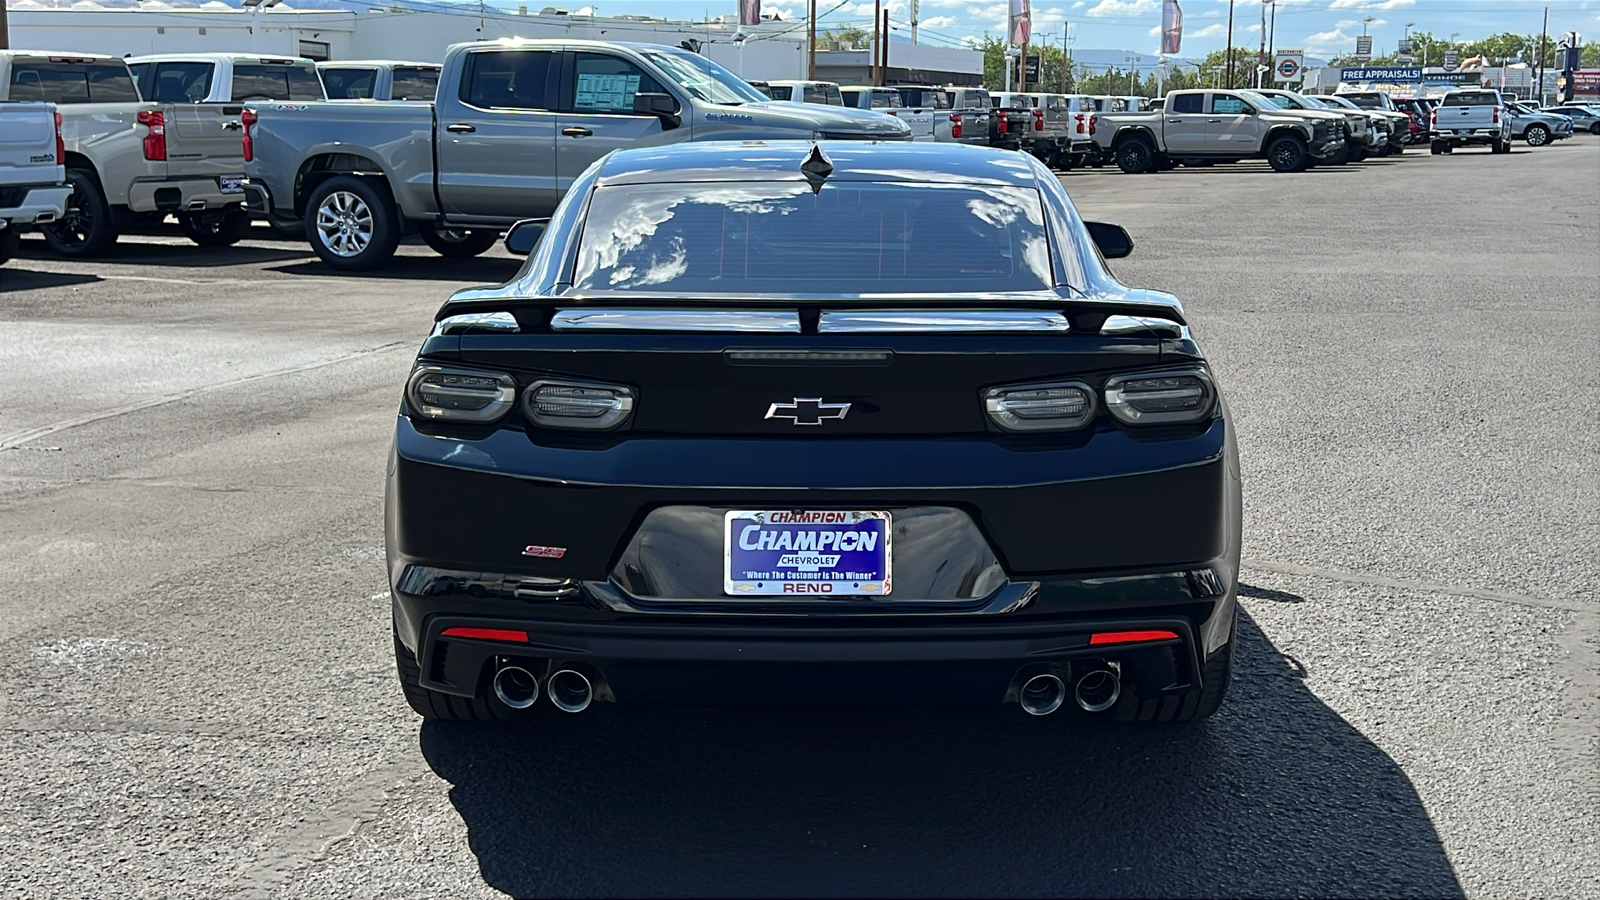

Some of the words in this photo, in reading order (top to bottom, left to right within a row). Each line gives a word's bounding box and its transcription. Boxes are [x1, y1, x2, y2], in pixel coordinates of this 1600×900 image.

[1343, 71, 1364, 79] FREE
[1365, 70, 1420, 79] APPRAISALS!
[770, 512, 846, 523] CHAMPION
[739, 525, 878, 551] CHAMPION
[521, 545, 567, 558] SS
[781, 556, 836, 565] CHEVROLET
[771, 571, 785, 580] The
[786, 571, 821, 580] Customer
[822, 571, 830, 580] Is
[831, 571, 845, 580] The
[783, 583, 833, 593] RENO
